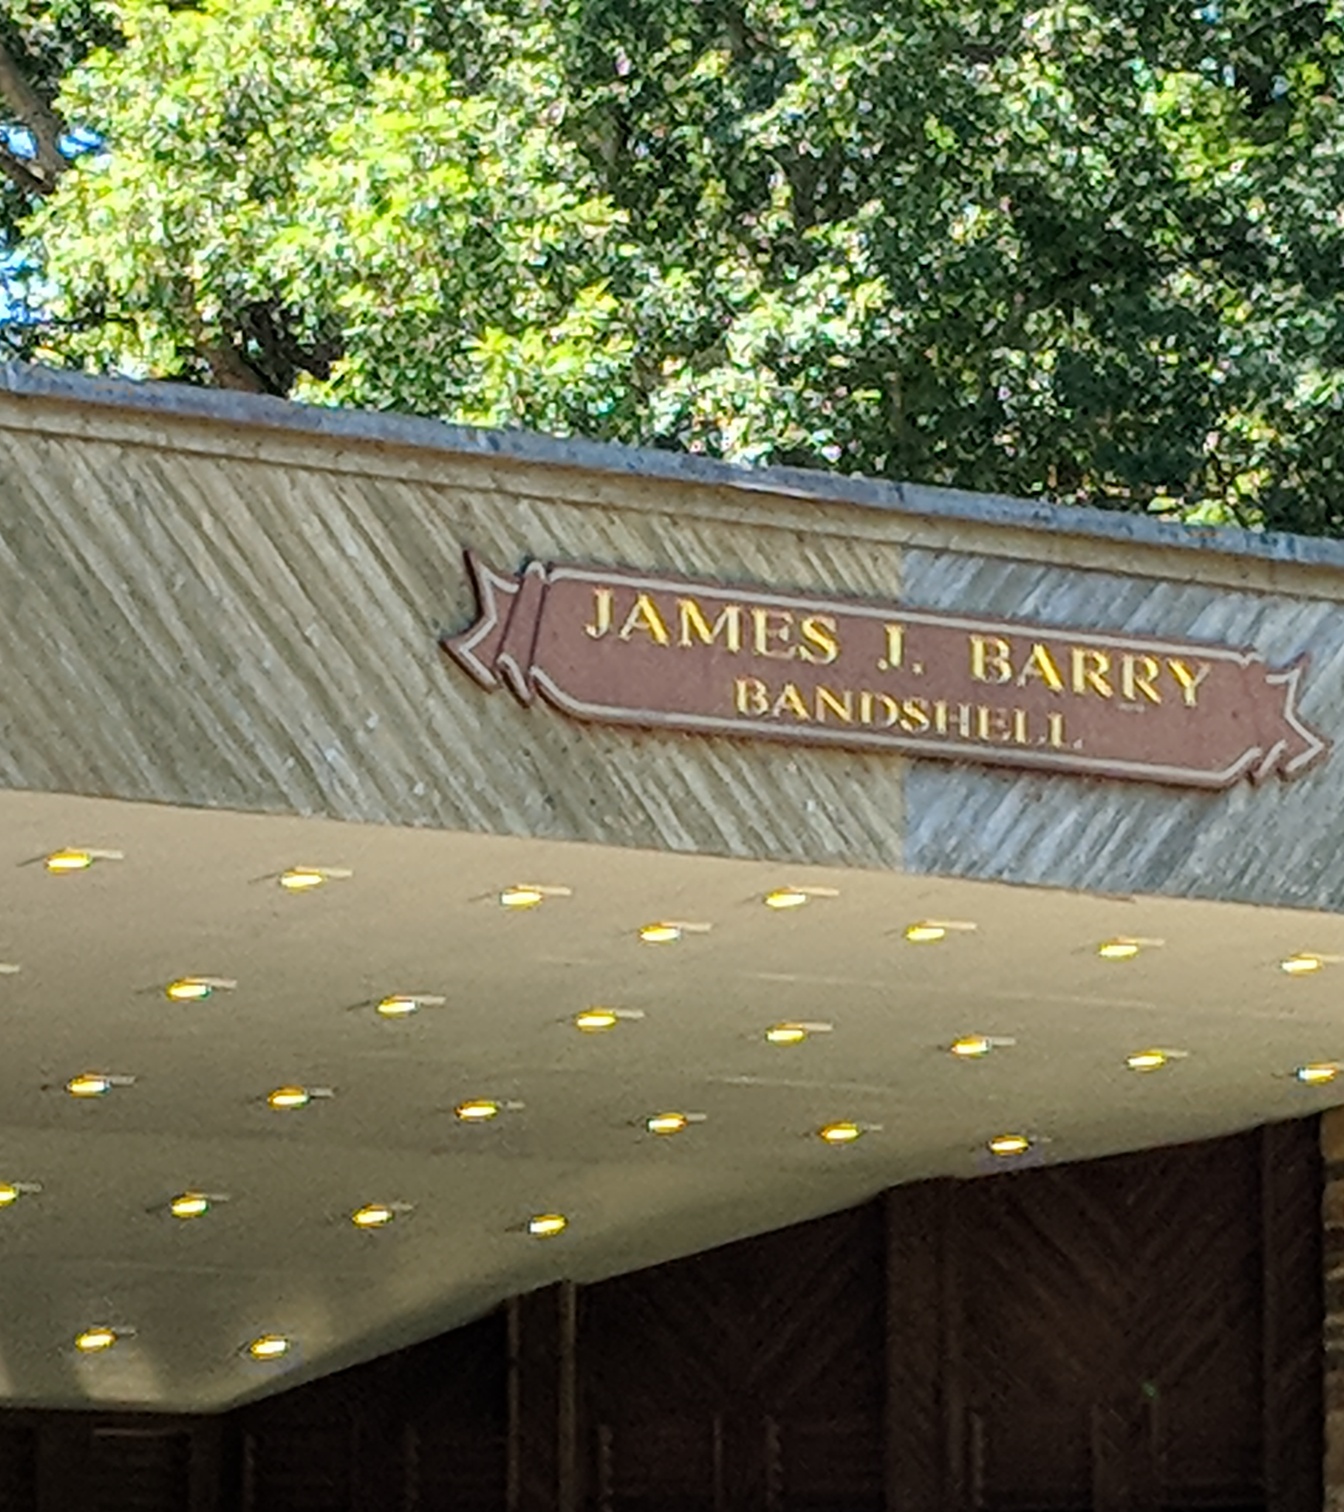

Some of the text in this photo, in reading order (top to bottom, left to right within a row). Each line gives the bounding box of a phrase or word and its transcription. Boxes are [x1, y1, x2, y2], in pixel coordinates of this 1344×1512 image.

[583, 586, 1212, 708] JAMES J. BARRY
[733, 674, 1084, 750] BANDSHELL
